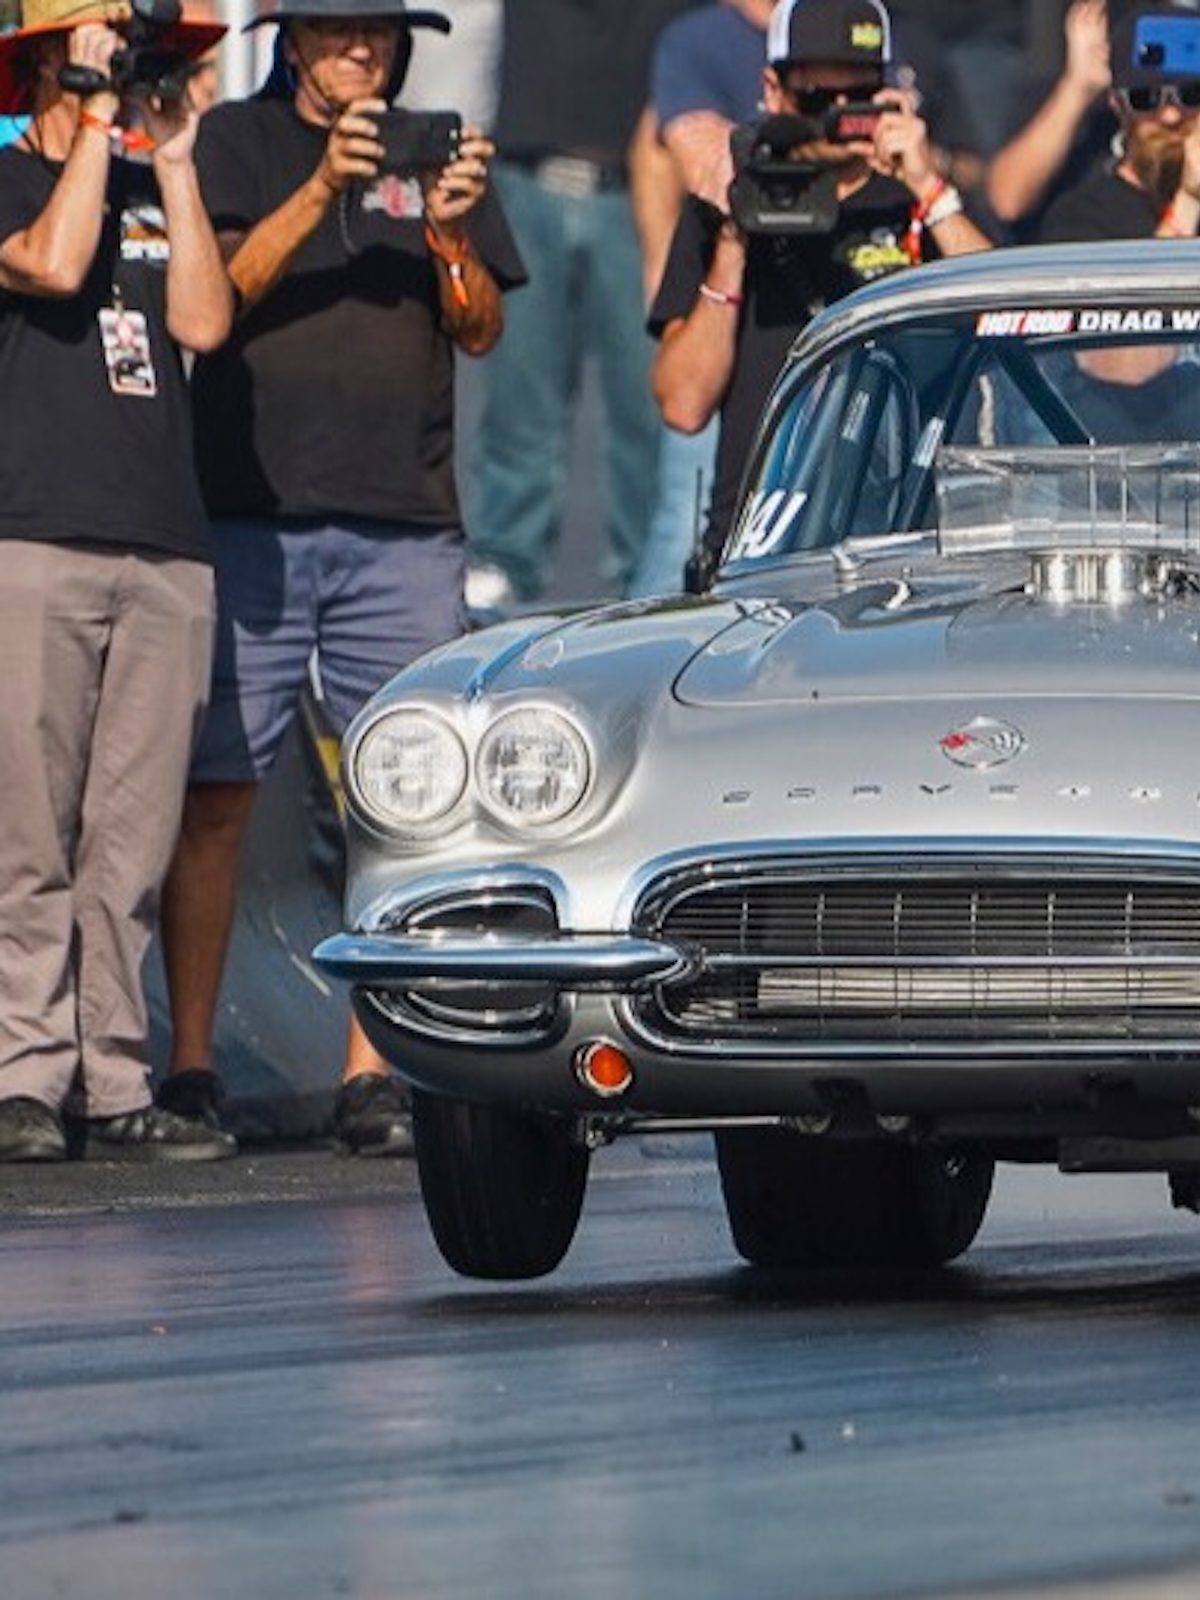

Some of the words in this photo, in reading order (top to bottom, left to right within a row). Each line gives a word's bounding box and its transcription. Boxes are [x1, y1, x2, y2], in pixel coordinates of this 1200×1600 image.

[976, 310, 1027, 336] HOT
[1023, 309, 1075, 334] ROD
[1078, 309, 1163, 331] DRAG
